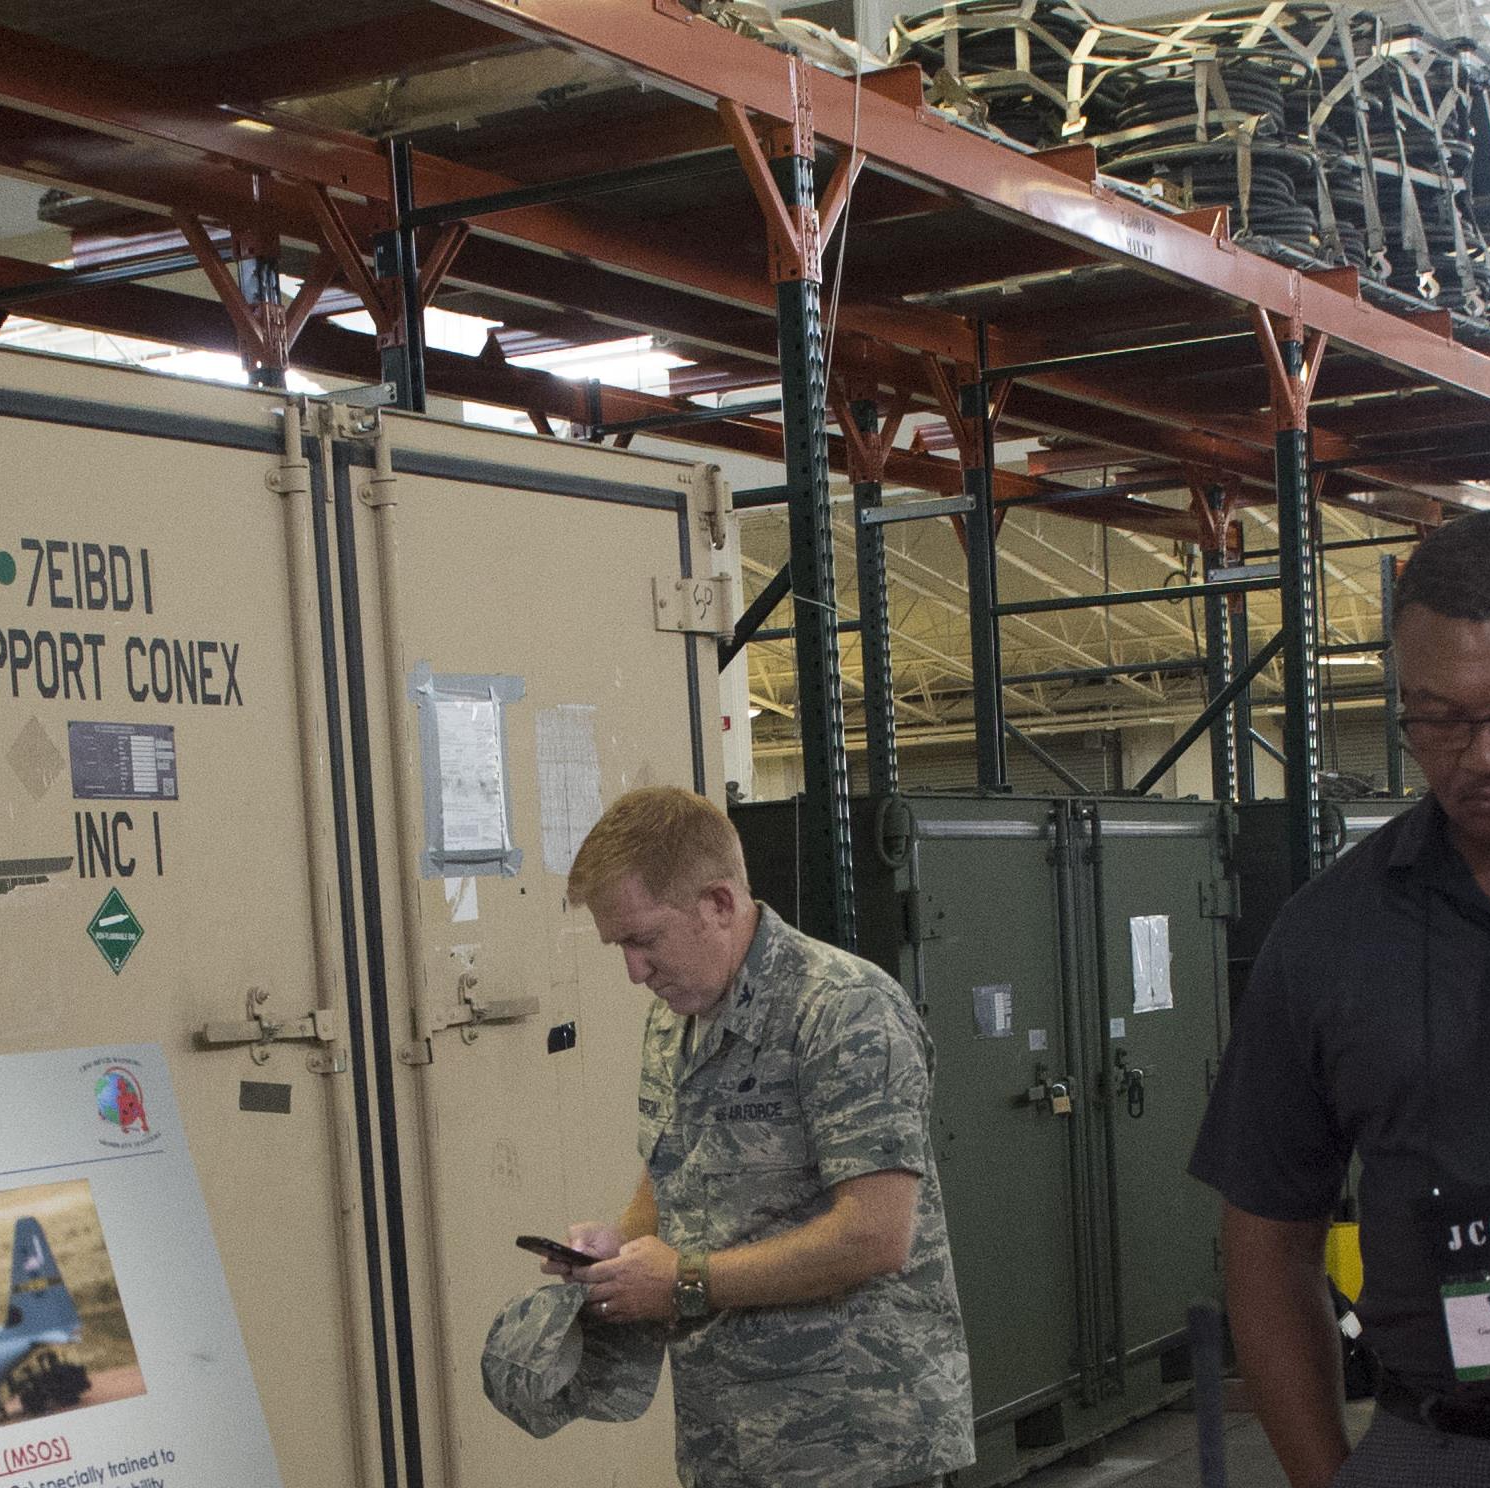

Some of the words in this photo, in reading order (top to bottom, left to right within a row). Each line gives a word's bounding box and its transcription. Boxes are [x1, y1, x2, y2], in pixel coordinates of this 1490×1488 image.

[125, 636, 244, 706] CONEX
[75, 811, 136, 878] INC
[3, 1436, 71, 1475] (MSOS)
[108, 1451, 159, 1478] trained
[159, 1448, 175, 1465] to
